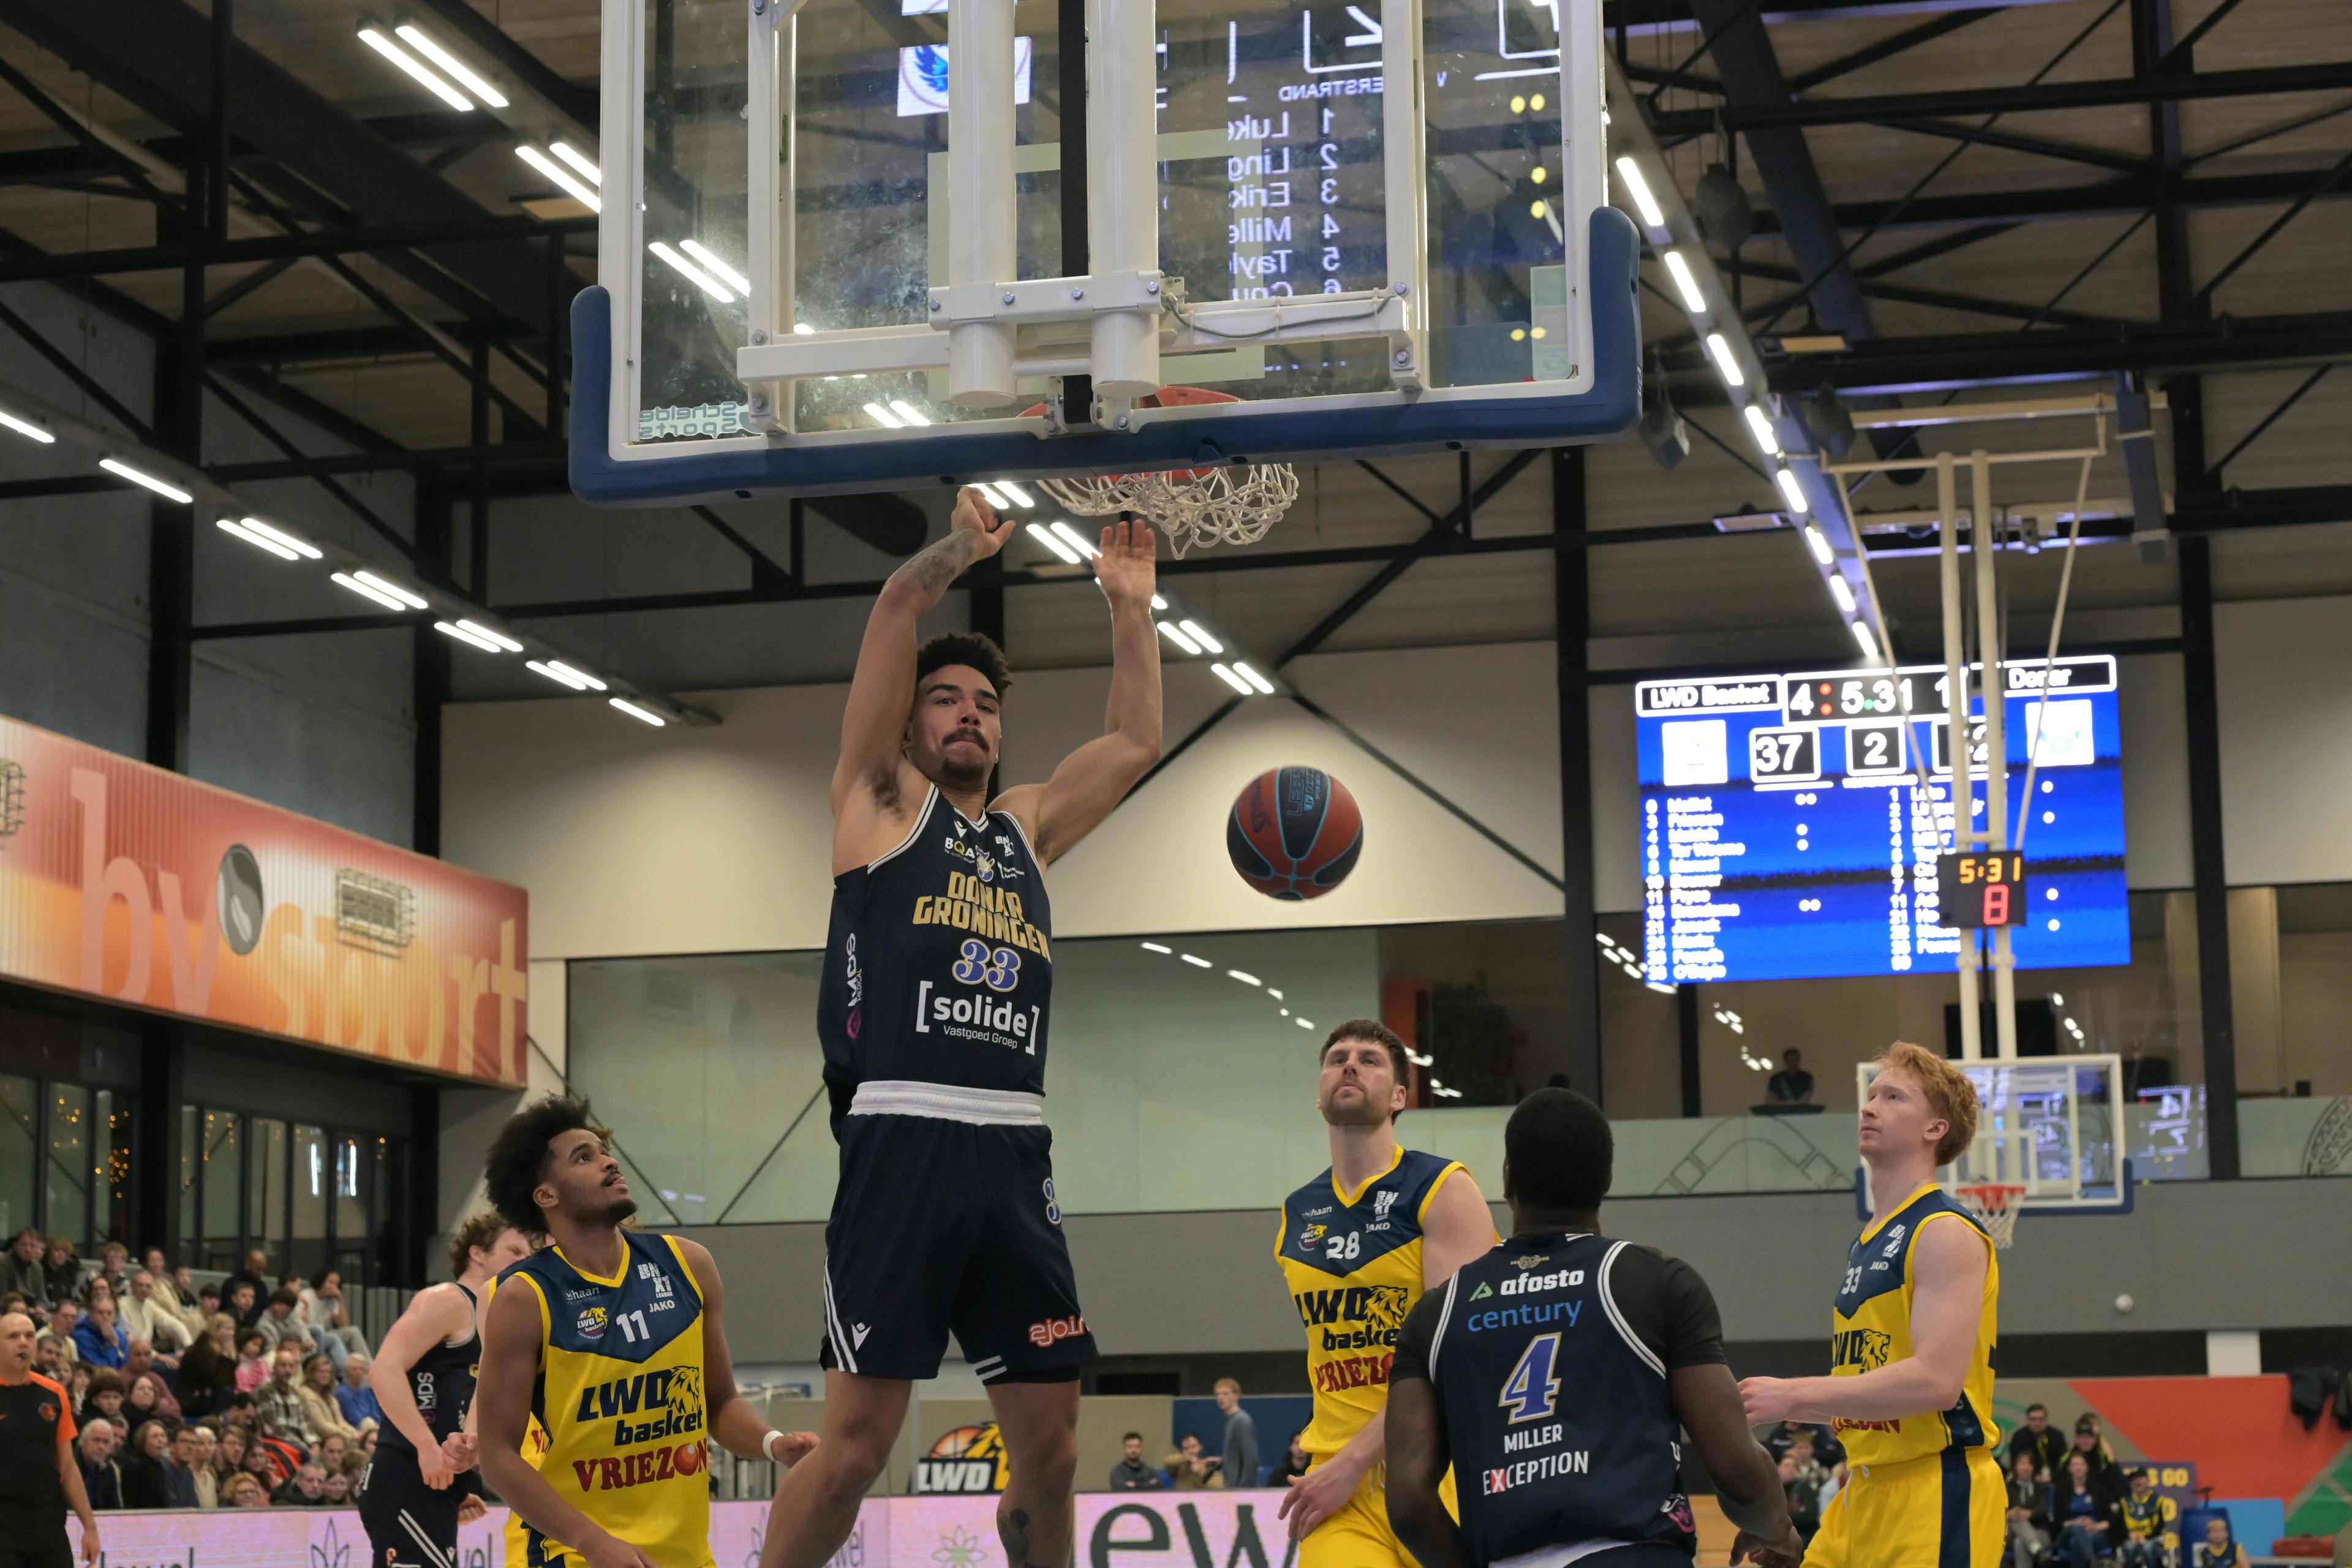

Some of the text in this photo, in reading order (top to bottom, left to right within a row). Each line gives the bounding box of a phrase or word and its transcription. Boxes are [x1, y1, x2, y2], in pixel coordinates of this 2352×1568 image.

[1650, 686, 1699, 709] LWD
[1754, 734, 1803, 772] 37
[1863, 732, 1889, 766] 2
[944, 837, 976, 859] BQA
[1959, 856, 2021, 884] 5:31
[948, 871, 1025, 923] DONAR
[1983, 884, 2009, 925] 8
[912, 895, 1052, 965] GRONINGEN
[952, 938, 1022, 993] 33
[943, 1025, 1018, 1050] Vastgoed Groep
[1365, 1222, 1390, 1234] JAKO
[1325, 1231, 1360, 1260] 28
[1500, 1270, 1585, 1296] afosto
[1841, 1265, 1863, 1295] 33
[649, 1299, 675, 1313] JAKO
[1468, 1300, 1583, 1333] century
[577, 1317, 595, 1329] LWD
[584, 1321, 605, 1333] basket
[616, 1310, 650, 1343] 11
[417, 1372, 434, 1411] MDS
[1498, 1332, 1562, 1425] 4
[576, 1369, 673, 1422] LWD
[613, 1404, 703, 1447] basket
[1504, 1424, 1563, 1454] MILLER
[572, 1438, 707, 1492] VRIEZON
[918, 1461, 991, 1491] LWD
[1482, 1450, 1589, 1496] EXCEPTION
